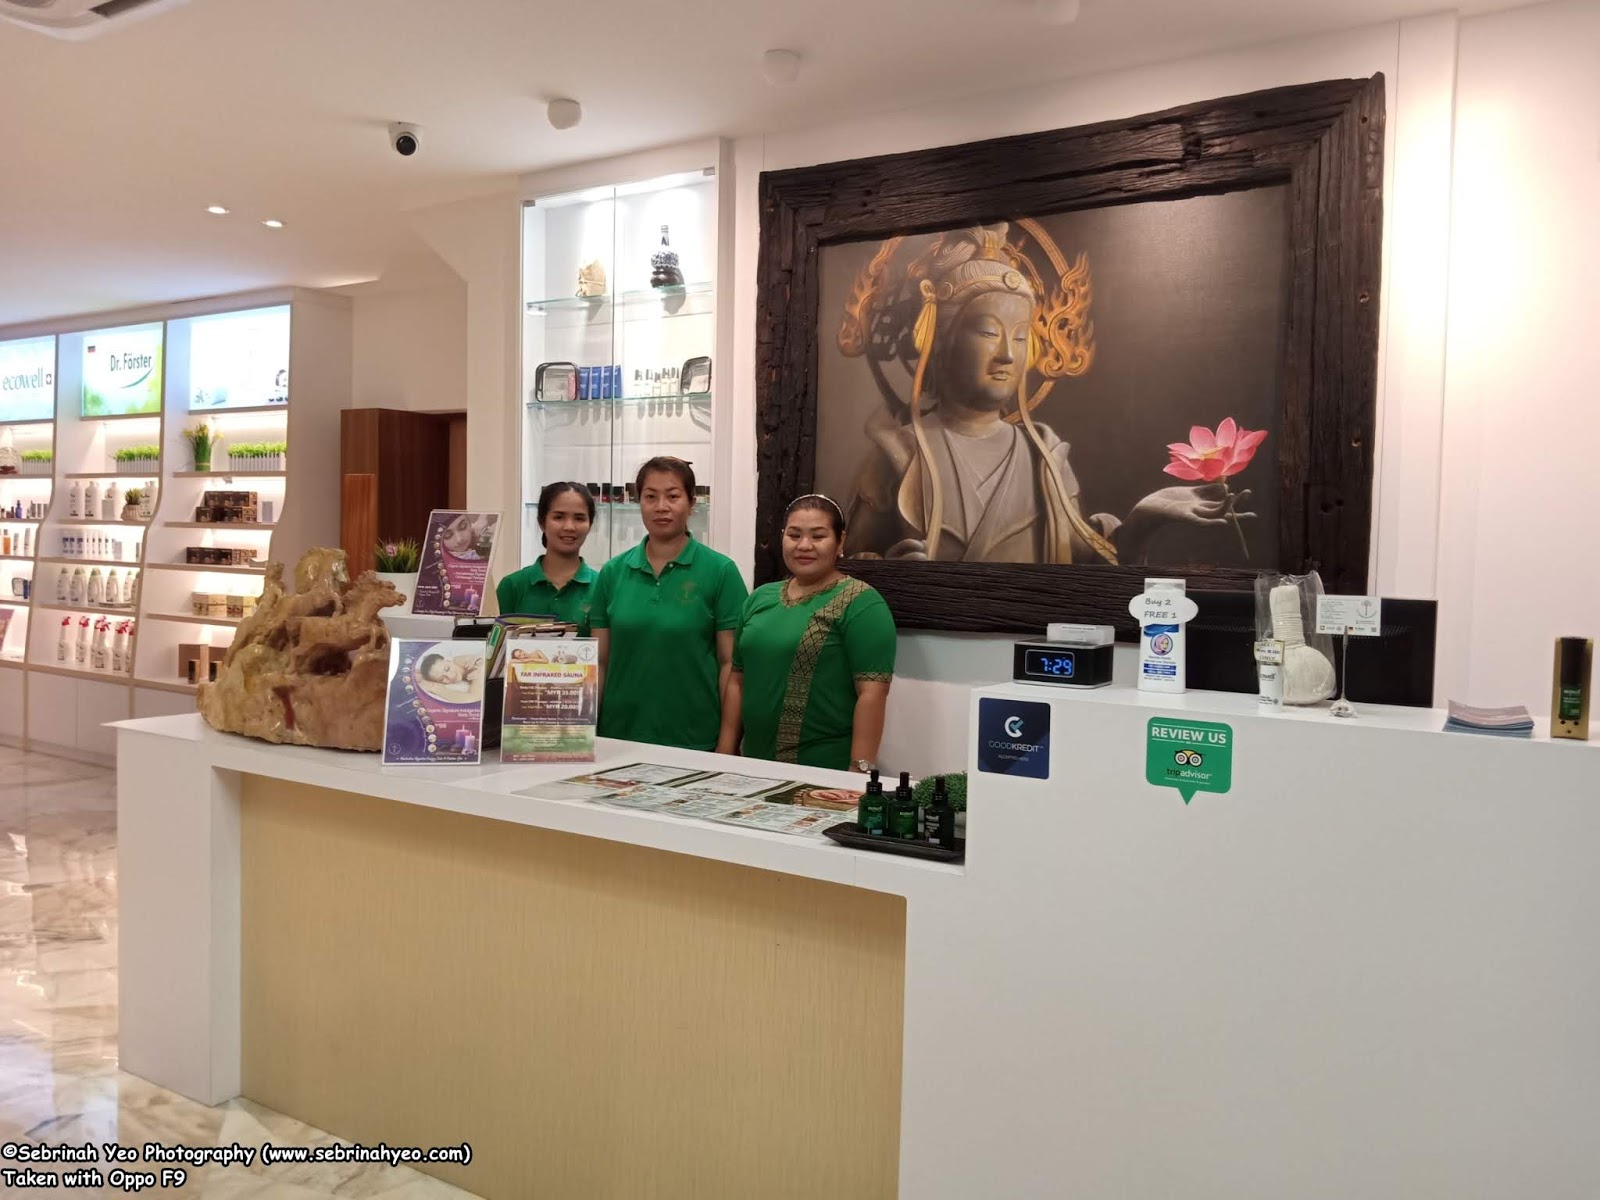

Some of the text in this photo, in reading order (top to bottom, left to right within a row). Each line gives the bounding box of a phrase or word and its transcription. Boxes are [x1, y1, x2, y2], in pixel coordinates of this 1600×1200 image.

[110, 353, 153, 371] Dr. Förster
[2, 367, 44, 391] ecowell
[1145, 597, 1163, 607] Buy
[1144, 610, 1169, 619] FREE
[1041, 657, 1072, 675] 7:29
[1151, 726, 1227, 744] REVIEW US
[988, 740, 1039, 752] GOODKREDIT
[1166, 768, 1210, 780] tripadvisor
